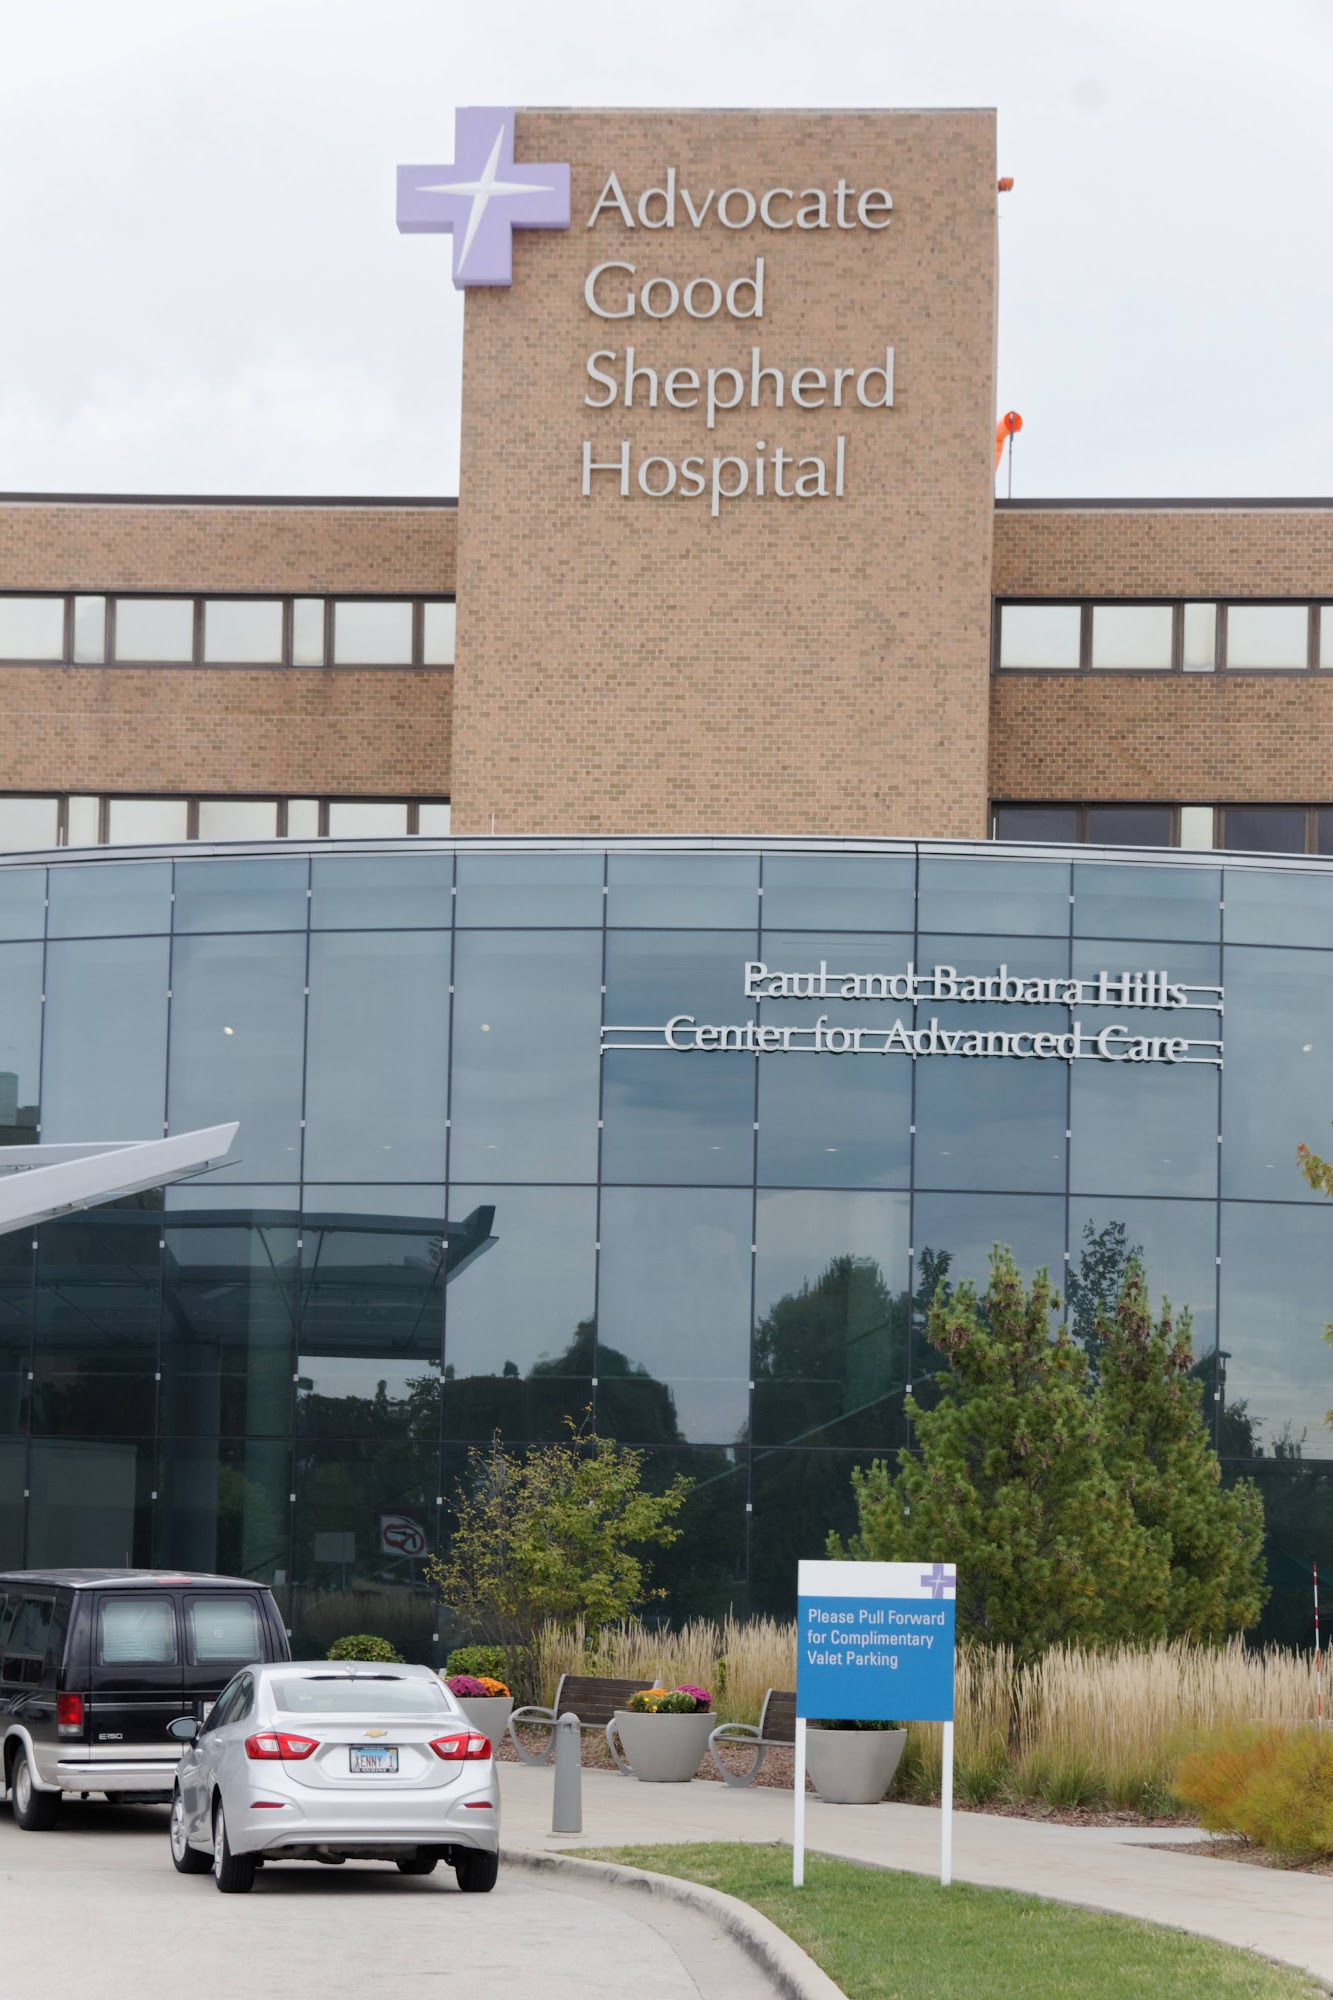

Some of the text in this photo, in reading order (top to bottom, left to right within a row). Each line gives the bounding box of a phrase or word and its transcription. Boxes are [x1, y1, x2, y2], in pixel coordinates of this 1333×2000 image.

[586, 167, 893, 230] Advocate
[584, 256, 765, 319] Good
[584, 346, 895, 429] Shepherd
[581, 435, 845, 517] Hospital
[744, 960, 1188, 1008] Paul and Barbara Hills
[664, 1014, 1189, 1062] Center for Advanced Care
[807, 1629, 934, 1649] for Complimentary
[808, 1608, 945, 1626] Please Pull Forward
[807, 1650, 898, 1670] Valet Parking
